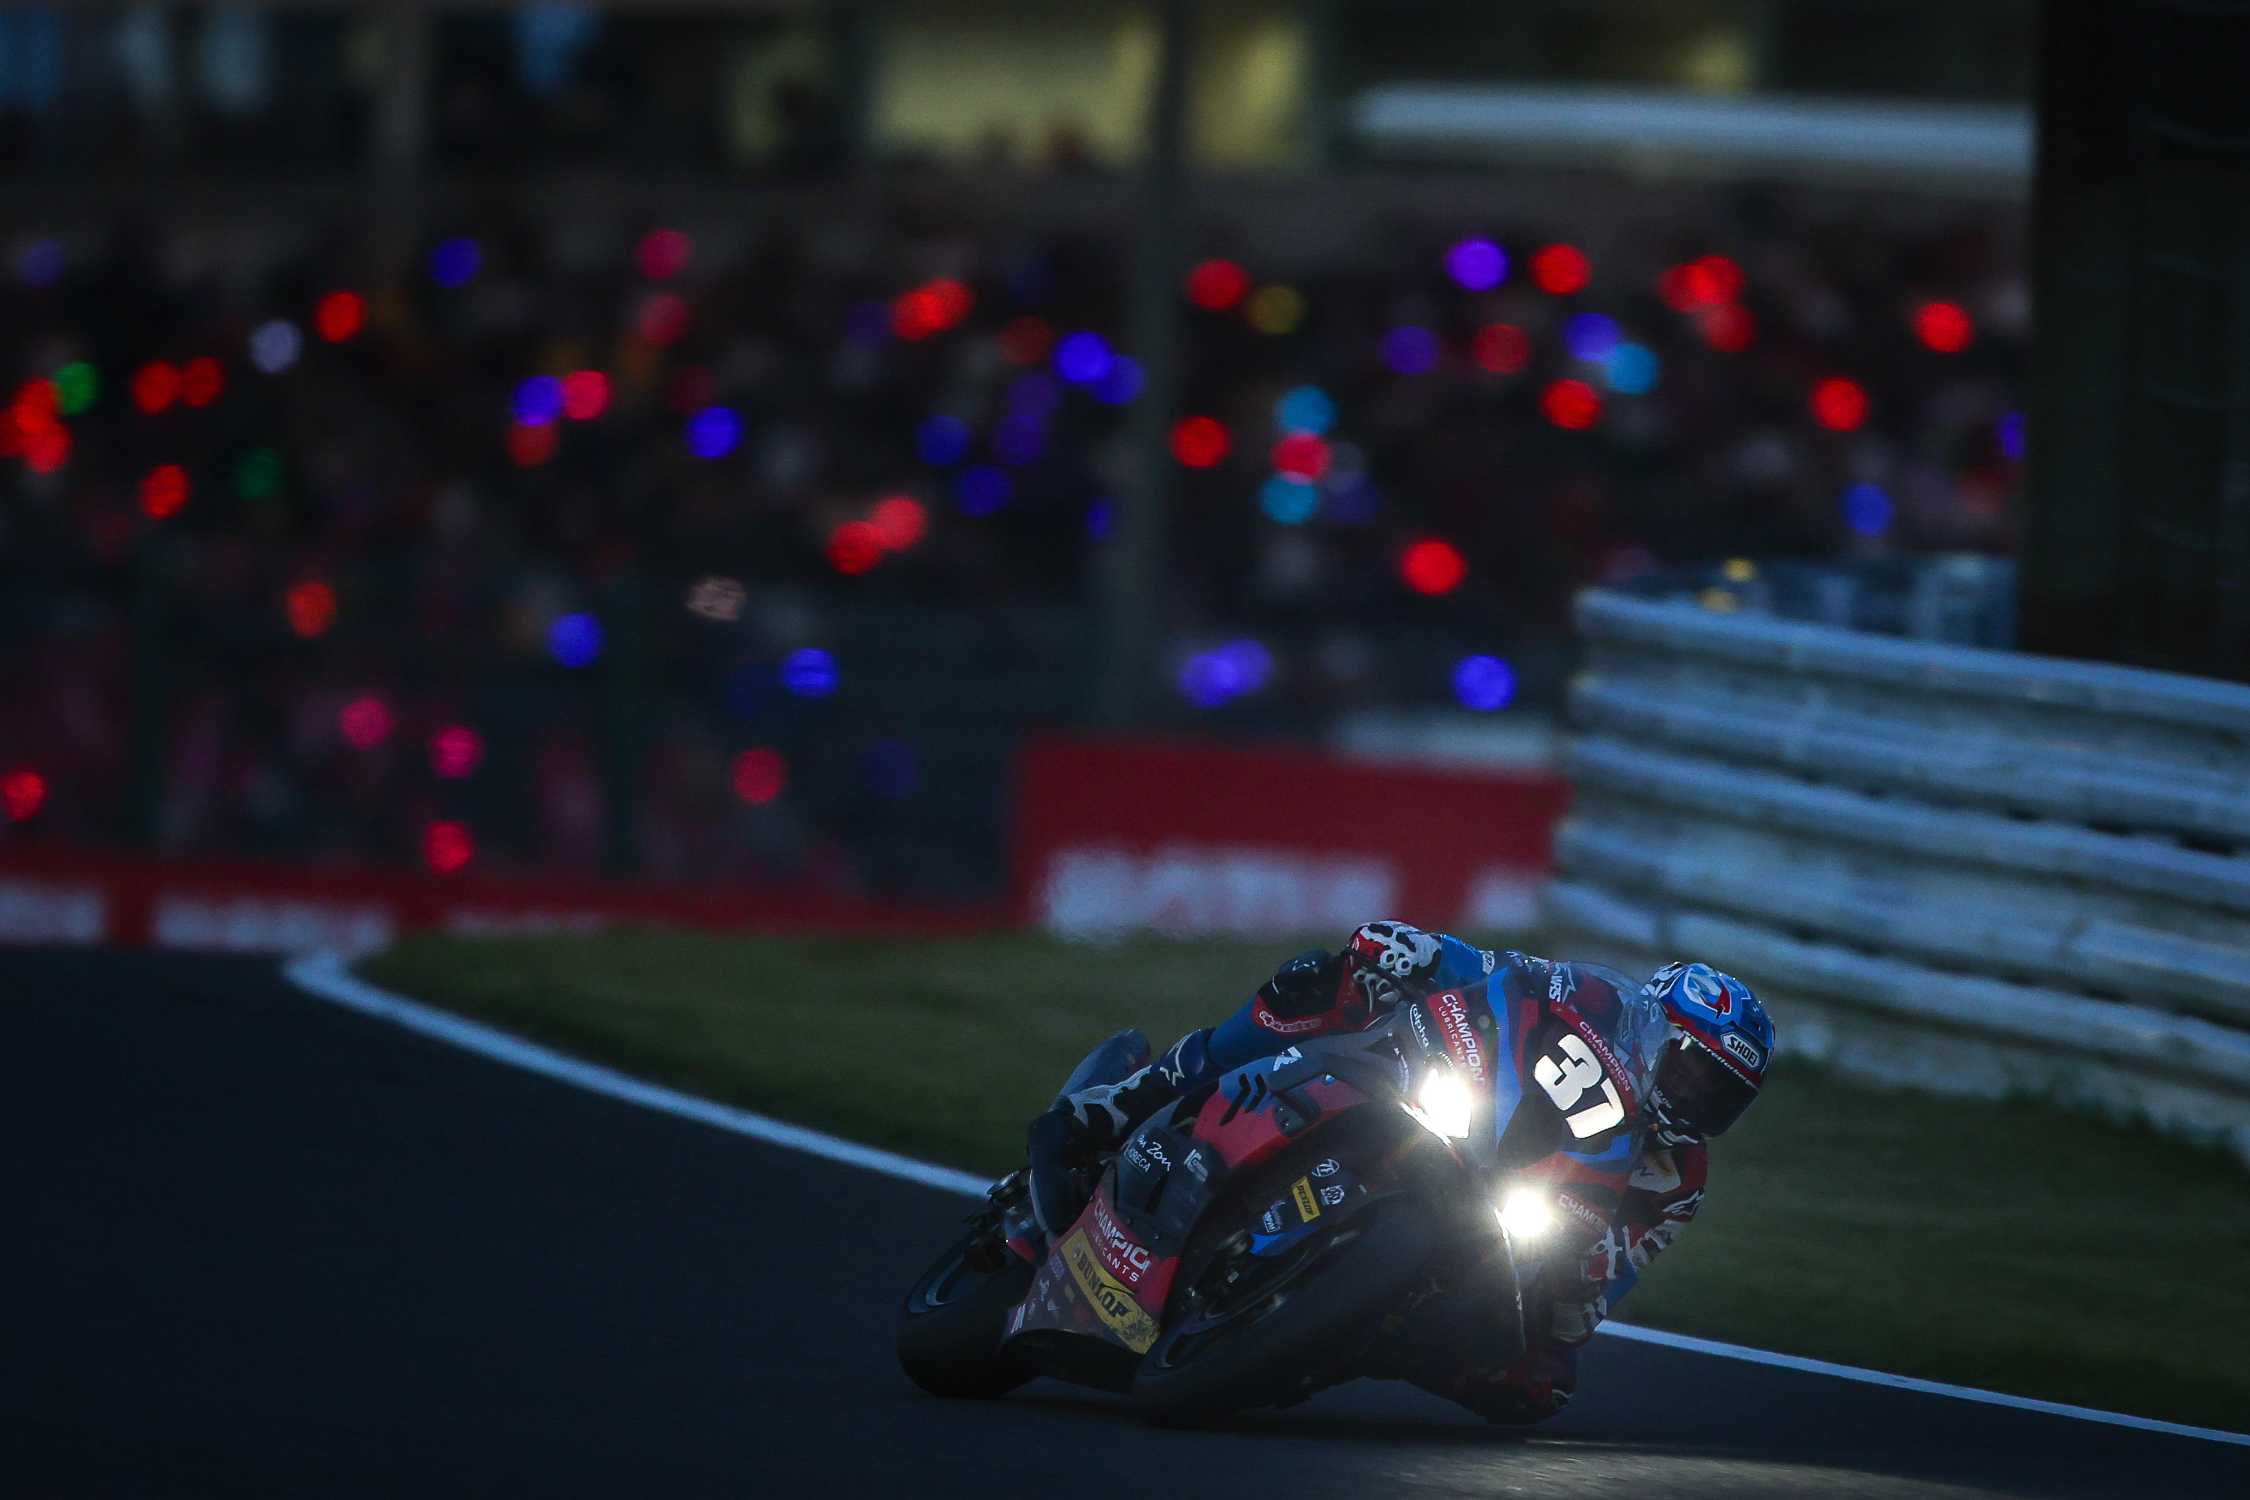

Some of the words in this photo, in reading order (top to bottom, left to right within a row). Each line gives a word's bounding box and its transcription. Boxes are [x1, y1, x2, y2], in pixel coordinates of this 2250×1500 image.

[1441, 993, 1486, 1083] CHAMPION
[1578, 1020, 1632, 1093] CHAMPION
[1534, 1033, 1625, 1139] 37
[1094, 1199, 1151, 1274] CHAMPIO
